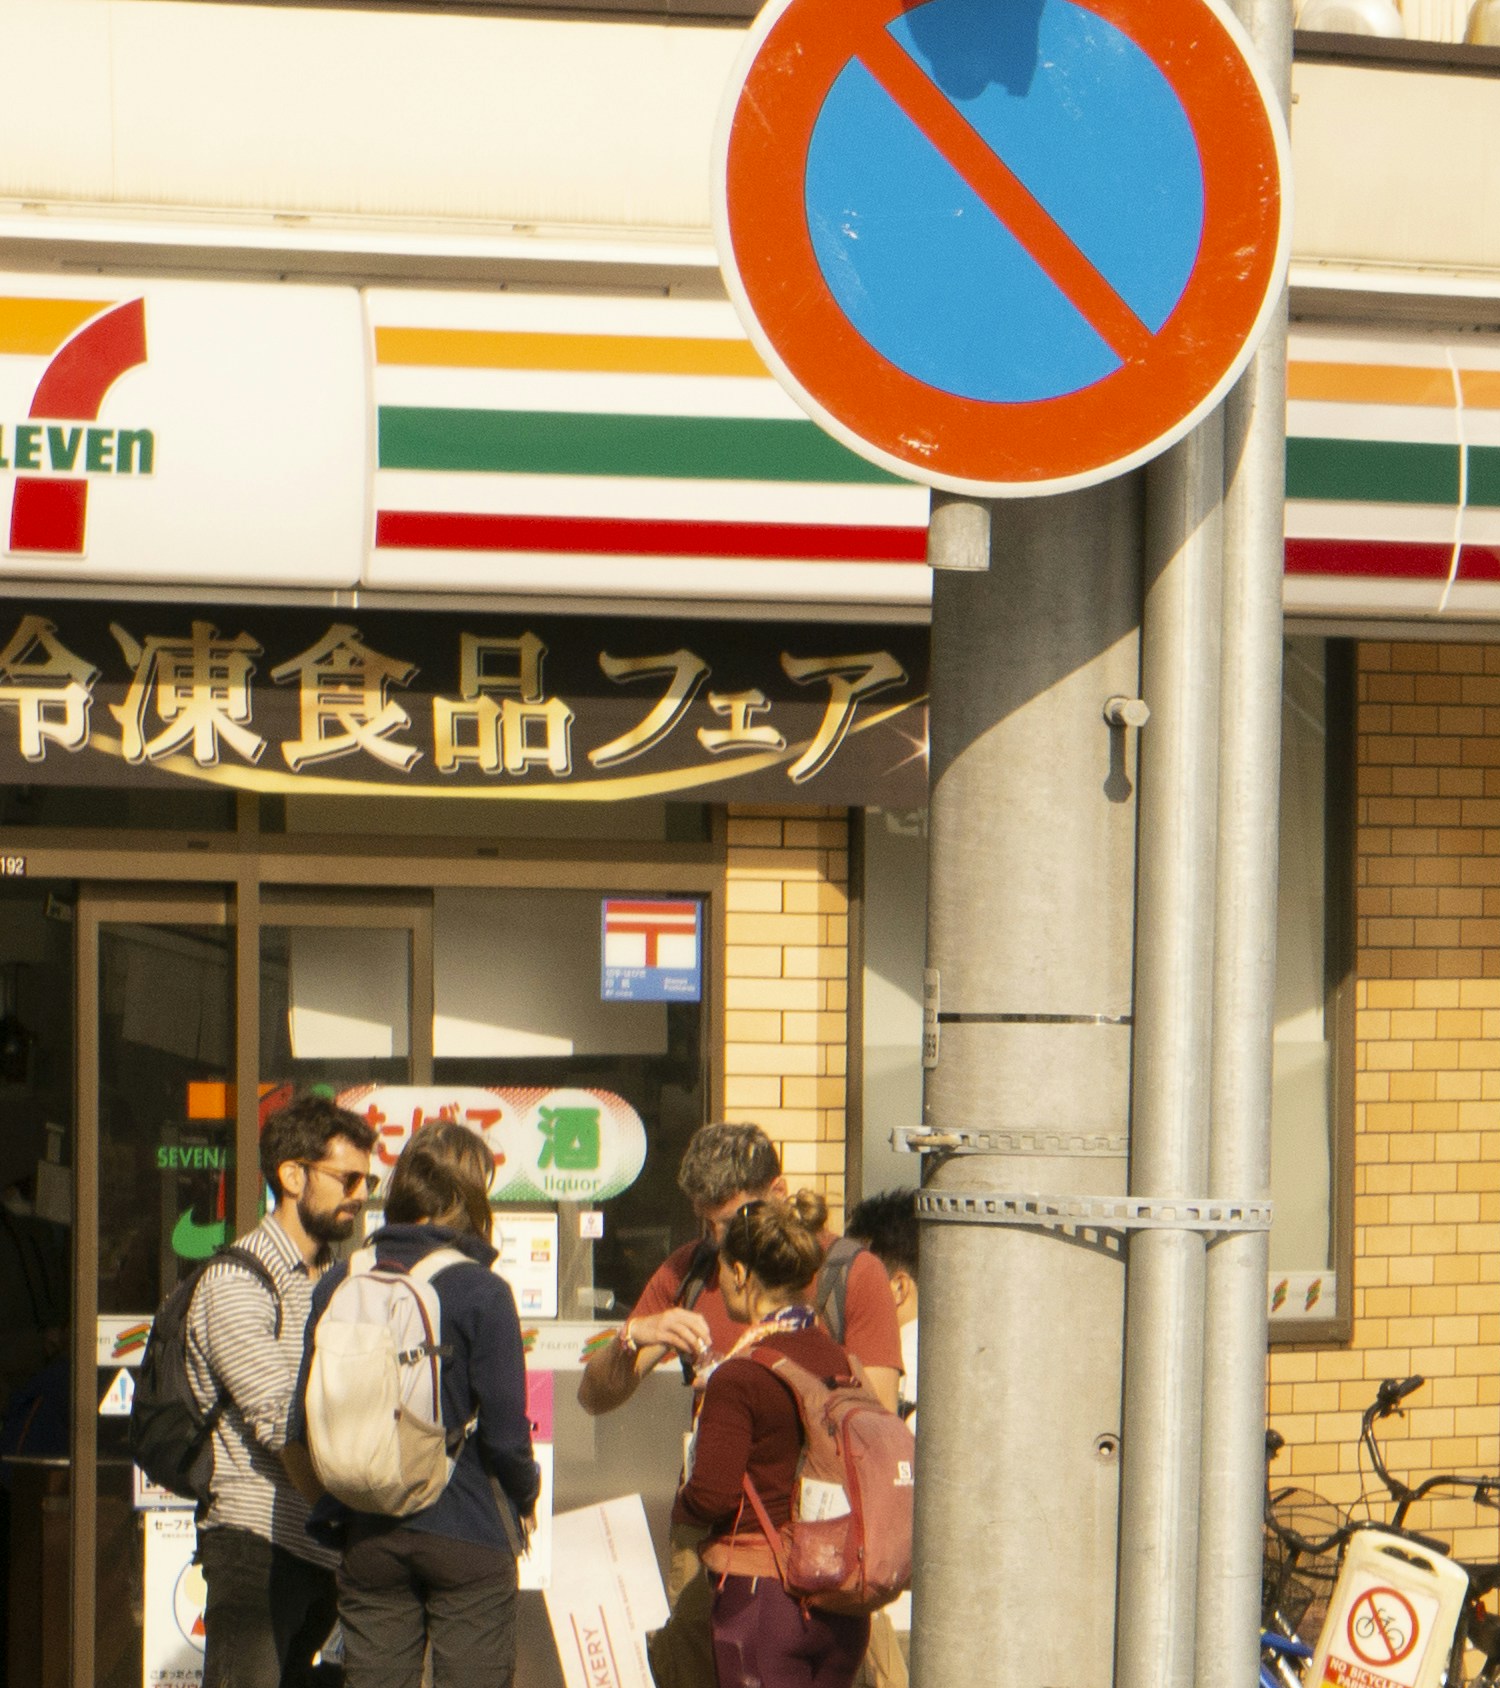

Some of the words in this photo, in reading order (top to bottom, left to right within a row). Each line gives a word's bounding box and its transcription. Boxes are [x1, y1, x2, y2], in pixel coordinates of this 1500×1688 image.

[0, 615, 909, 784] 冷凍食品フェア
[537, 1105, 601, 1170] 酒
[544, 1174, 600, 1193] liquor
[1329, 1658, 1347, 1674] NO
